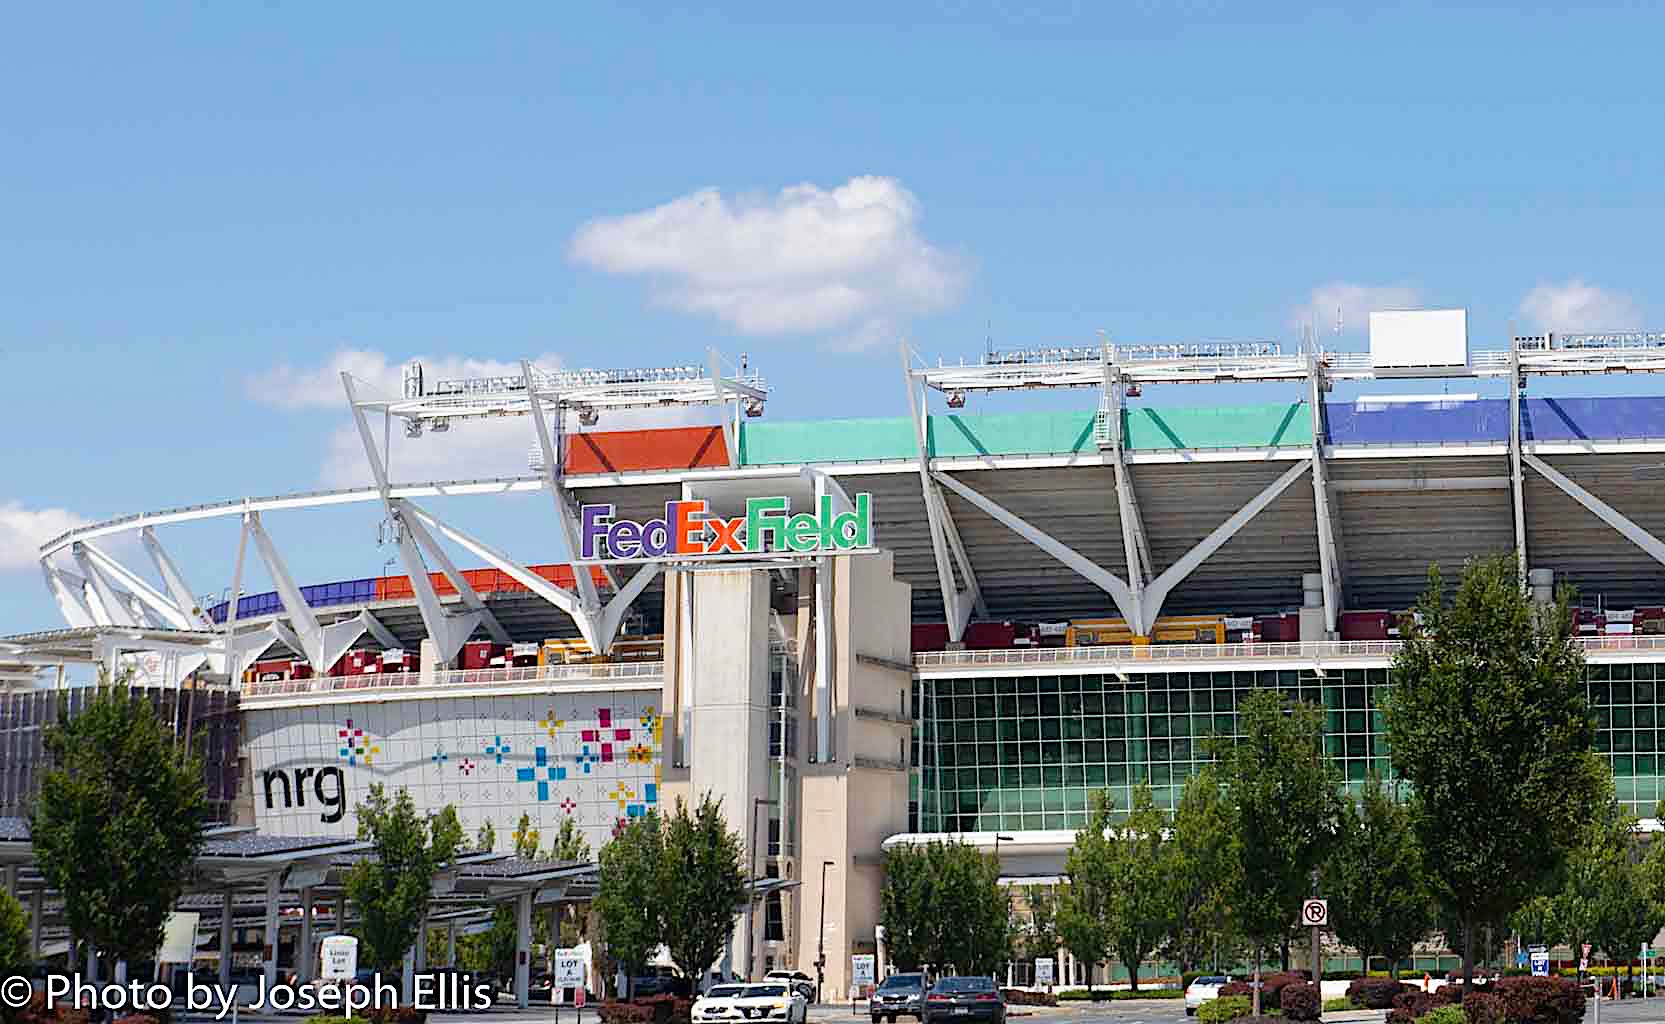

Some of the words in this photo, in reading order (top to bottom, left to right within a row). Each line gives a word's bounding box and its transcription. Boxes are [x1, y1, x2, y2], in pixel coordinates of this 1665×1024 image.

[580, 493, 872, 560] FedExField
[263, 766, 346, 823] nrg
[561, 960, 577, 969] LOT
